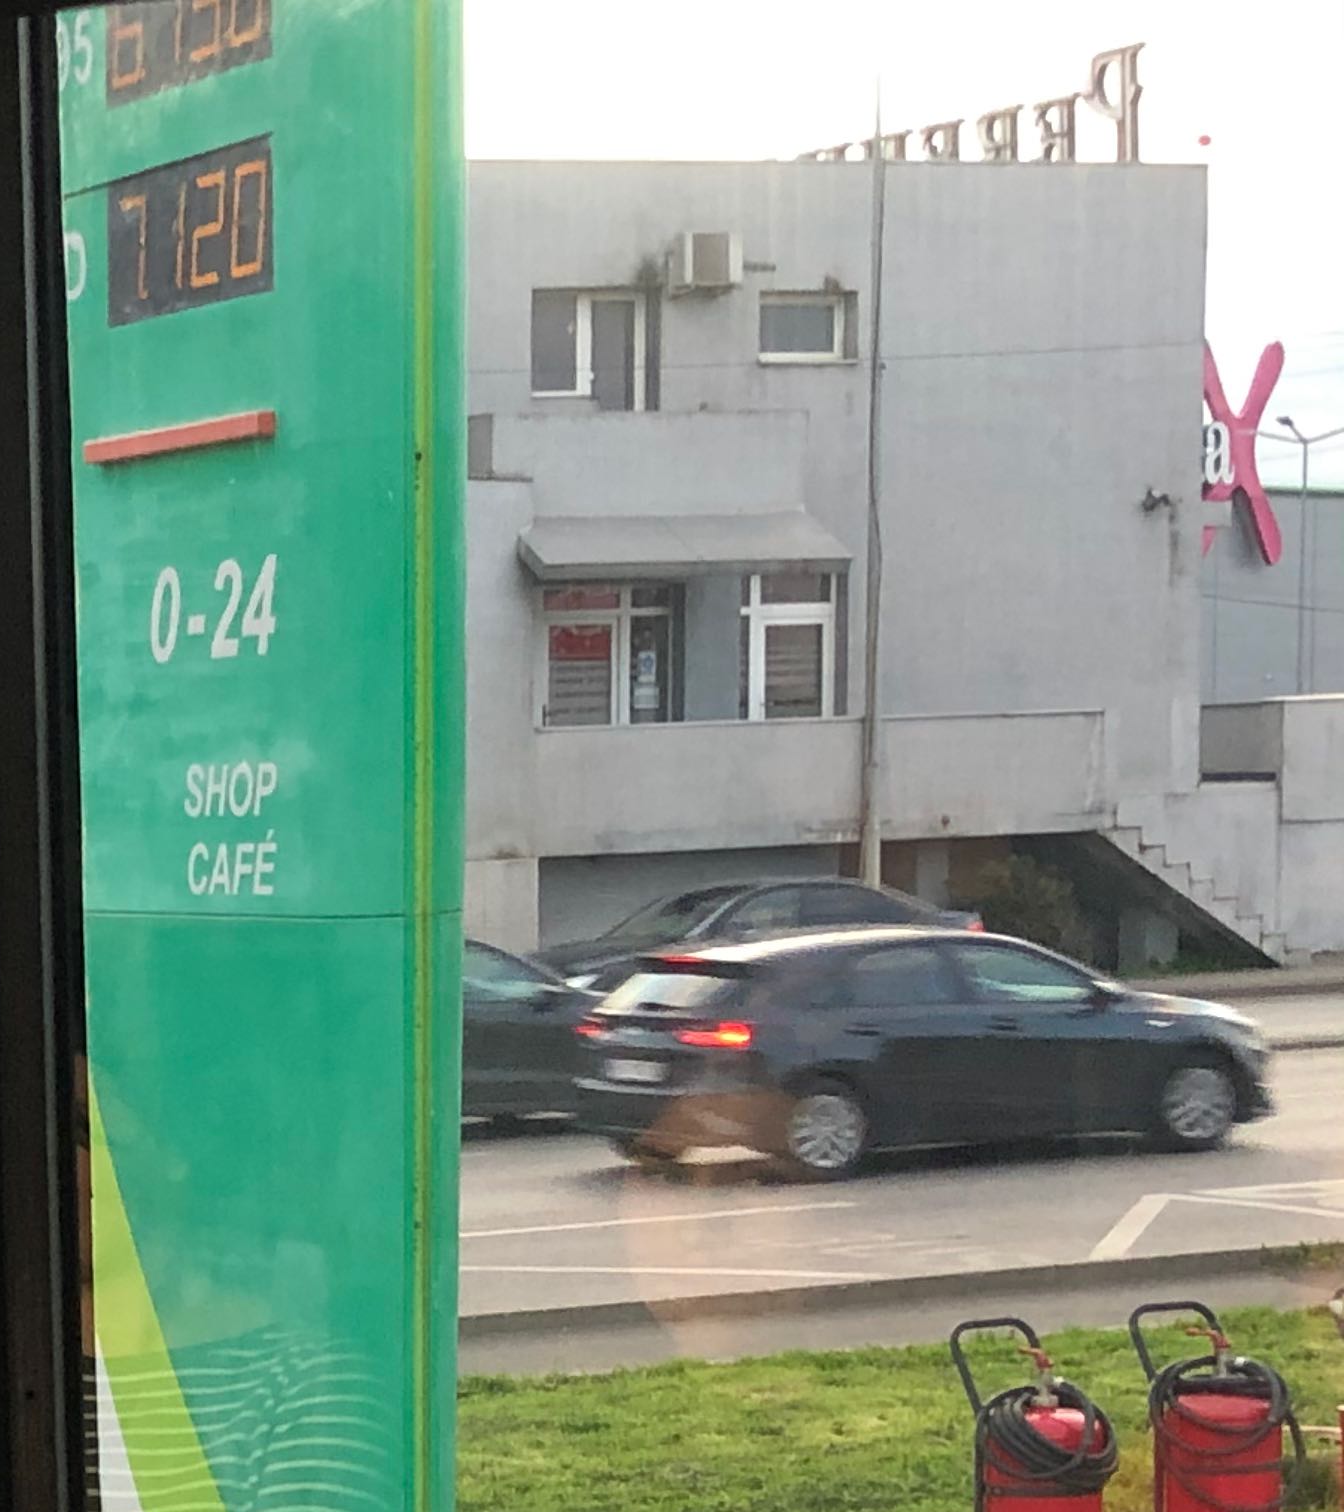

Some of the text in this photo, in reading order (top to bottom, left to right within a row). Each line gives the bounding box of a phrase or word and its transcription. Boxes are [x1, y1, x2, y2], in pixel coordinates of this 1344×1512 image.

[150, 553, 278, 664] 0-24
[184, 761, 278, 818] SHOP
[187, 828, 278, 895] CAFÉ
